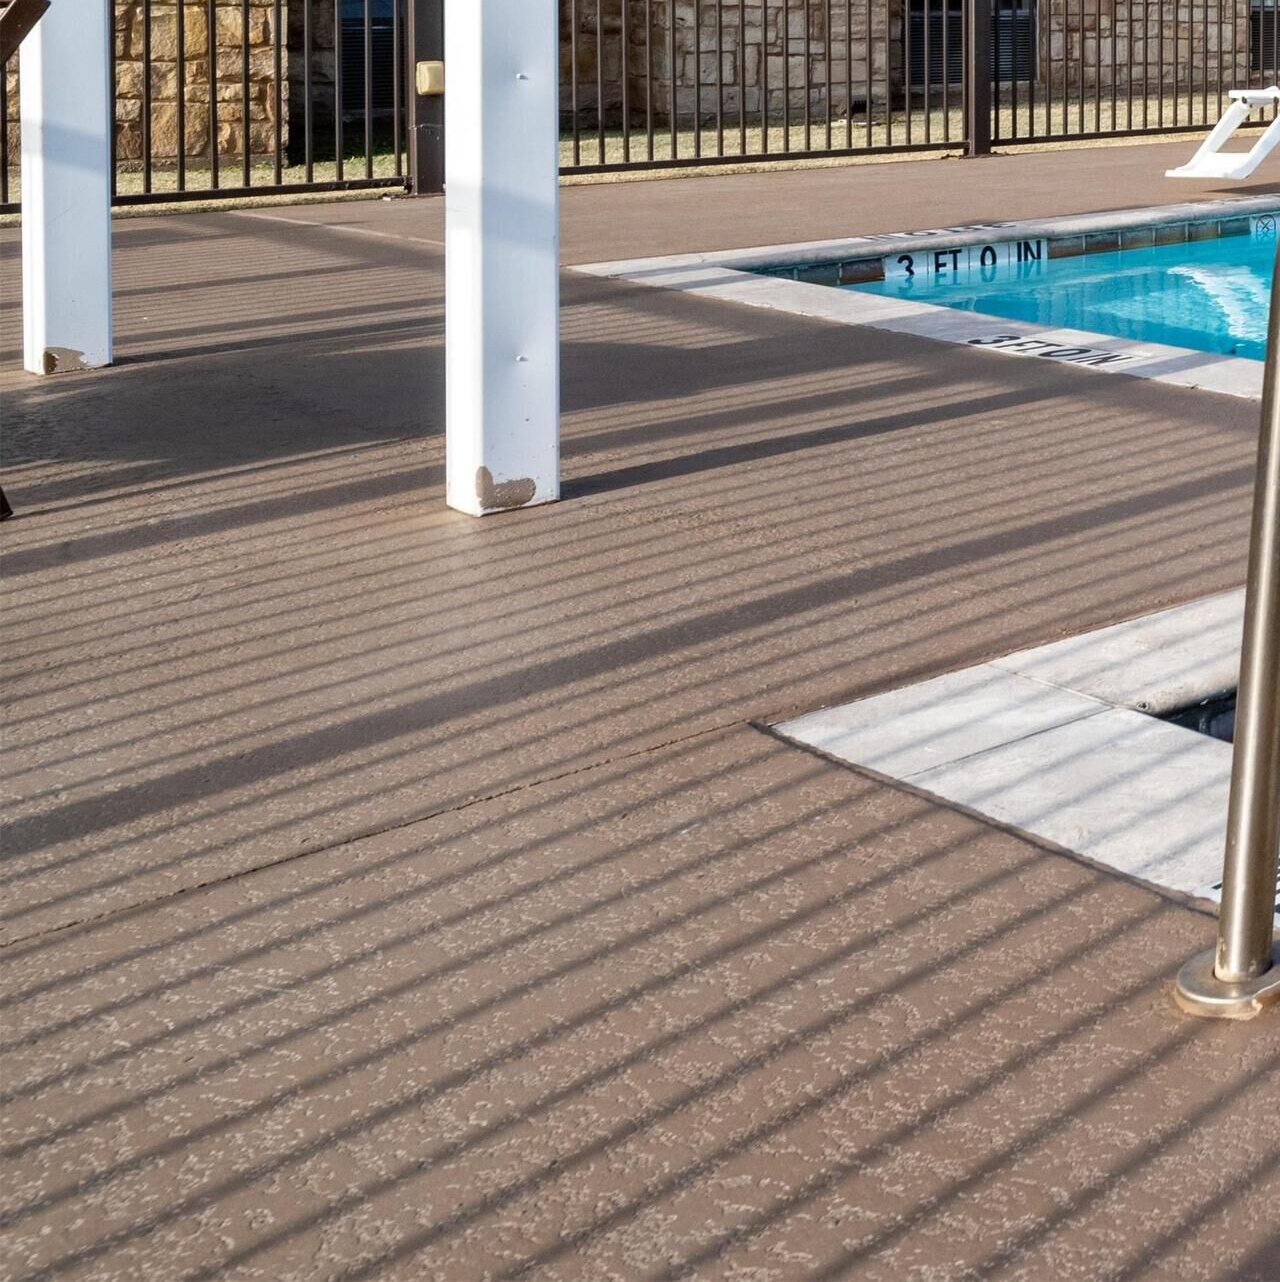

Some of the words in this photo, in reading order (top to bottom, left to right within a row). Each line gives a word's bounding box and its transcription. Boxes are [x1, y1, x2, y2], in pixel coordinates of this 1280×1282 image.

[897, 254, 915, 275] 3
[935, 248, 962, 273] FT
[980, 245, 997, 267] 0
[1017, 240, 1041, 262] IN
[968, 335, 1021, 344] 3
[995, 340, 1068, 352] FT
[1066, 353, 1133, 365] IN
